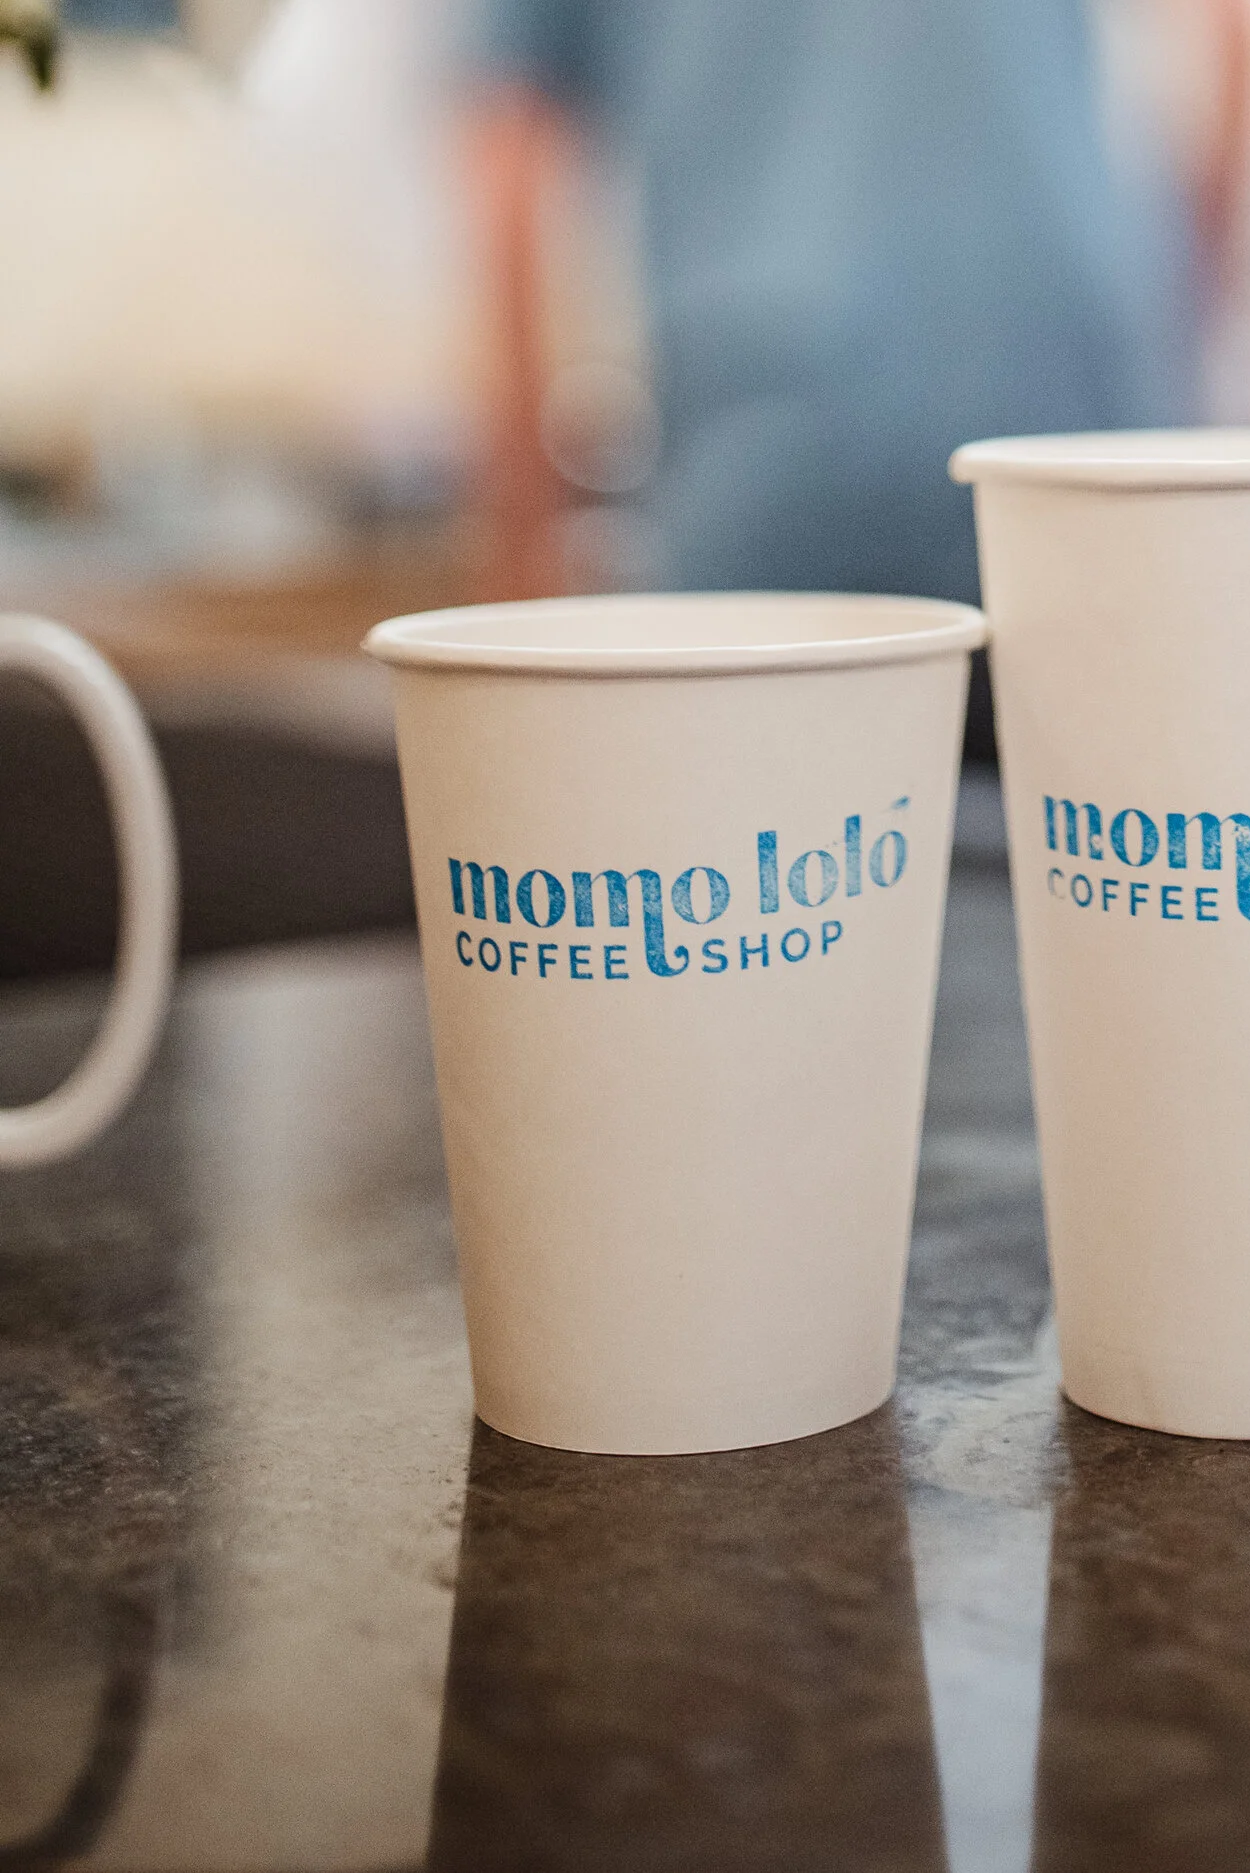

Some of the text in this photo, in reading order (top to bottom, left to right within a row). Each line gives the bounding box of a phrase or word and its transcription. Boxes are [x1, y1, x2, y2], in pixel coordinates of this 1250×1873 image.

[448, 857, 731, 978] momo
[1047, 867, 1220, 923] COFFEE
[455, 919, 844, 980] COFFEE SHOP
